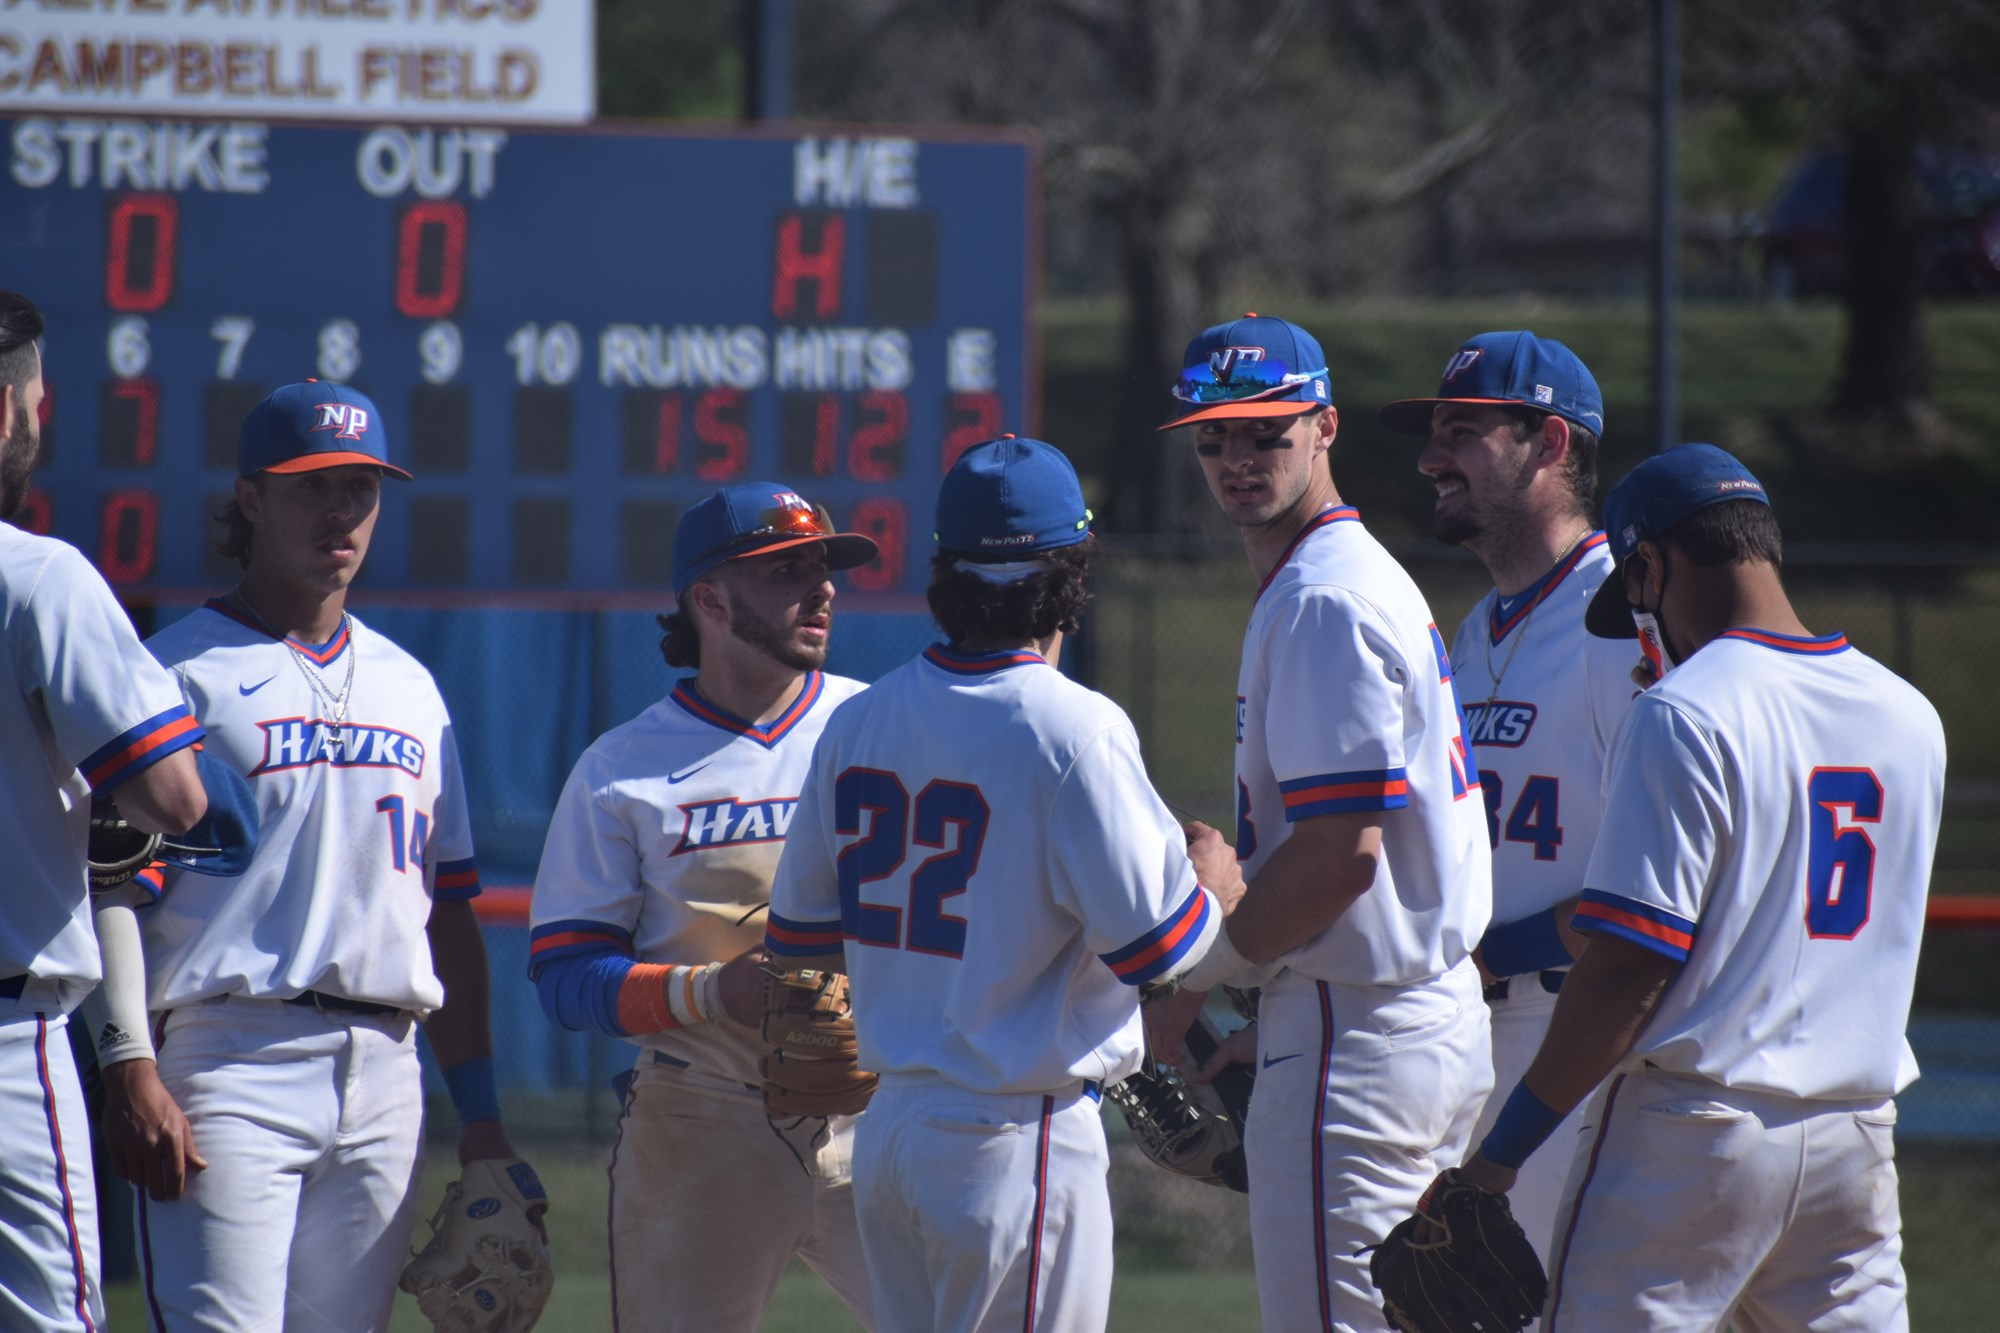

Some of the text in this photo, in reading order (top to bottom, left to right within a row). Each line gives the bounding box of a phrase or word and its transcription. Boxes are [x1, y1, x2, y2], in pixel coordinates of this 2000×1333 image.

[356, 46, 540, 100] FIELD
[11, 120, 918, 207] STRIKE OUT H/E
[106, 195, 845, 319] 0 0 H
[107, 314, 997, 392] 6 7 8 9 10 RUNS HITS E
[114, 377, 161, 465] 7
[656, 387, 749, 481] 15
[812, 387, 909, 484] 12
[314, 404, 368, 438] NP
[102, 490, 158, 584] 0
[265, 720, 424, 775] HAWKS
[1464, 705, 1534, 743] WKS
[374, 794, 429, 874] 14
[684, 802, 798, 846] HAW
[835, 766, 991, 961] 22
[1804, 766, 1885, 941] 6
[785, 1031, 839, 1047] A2000
